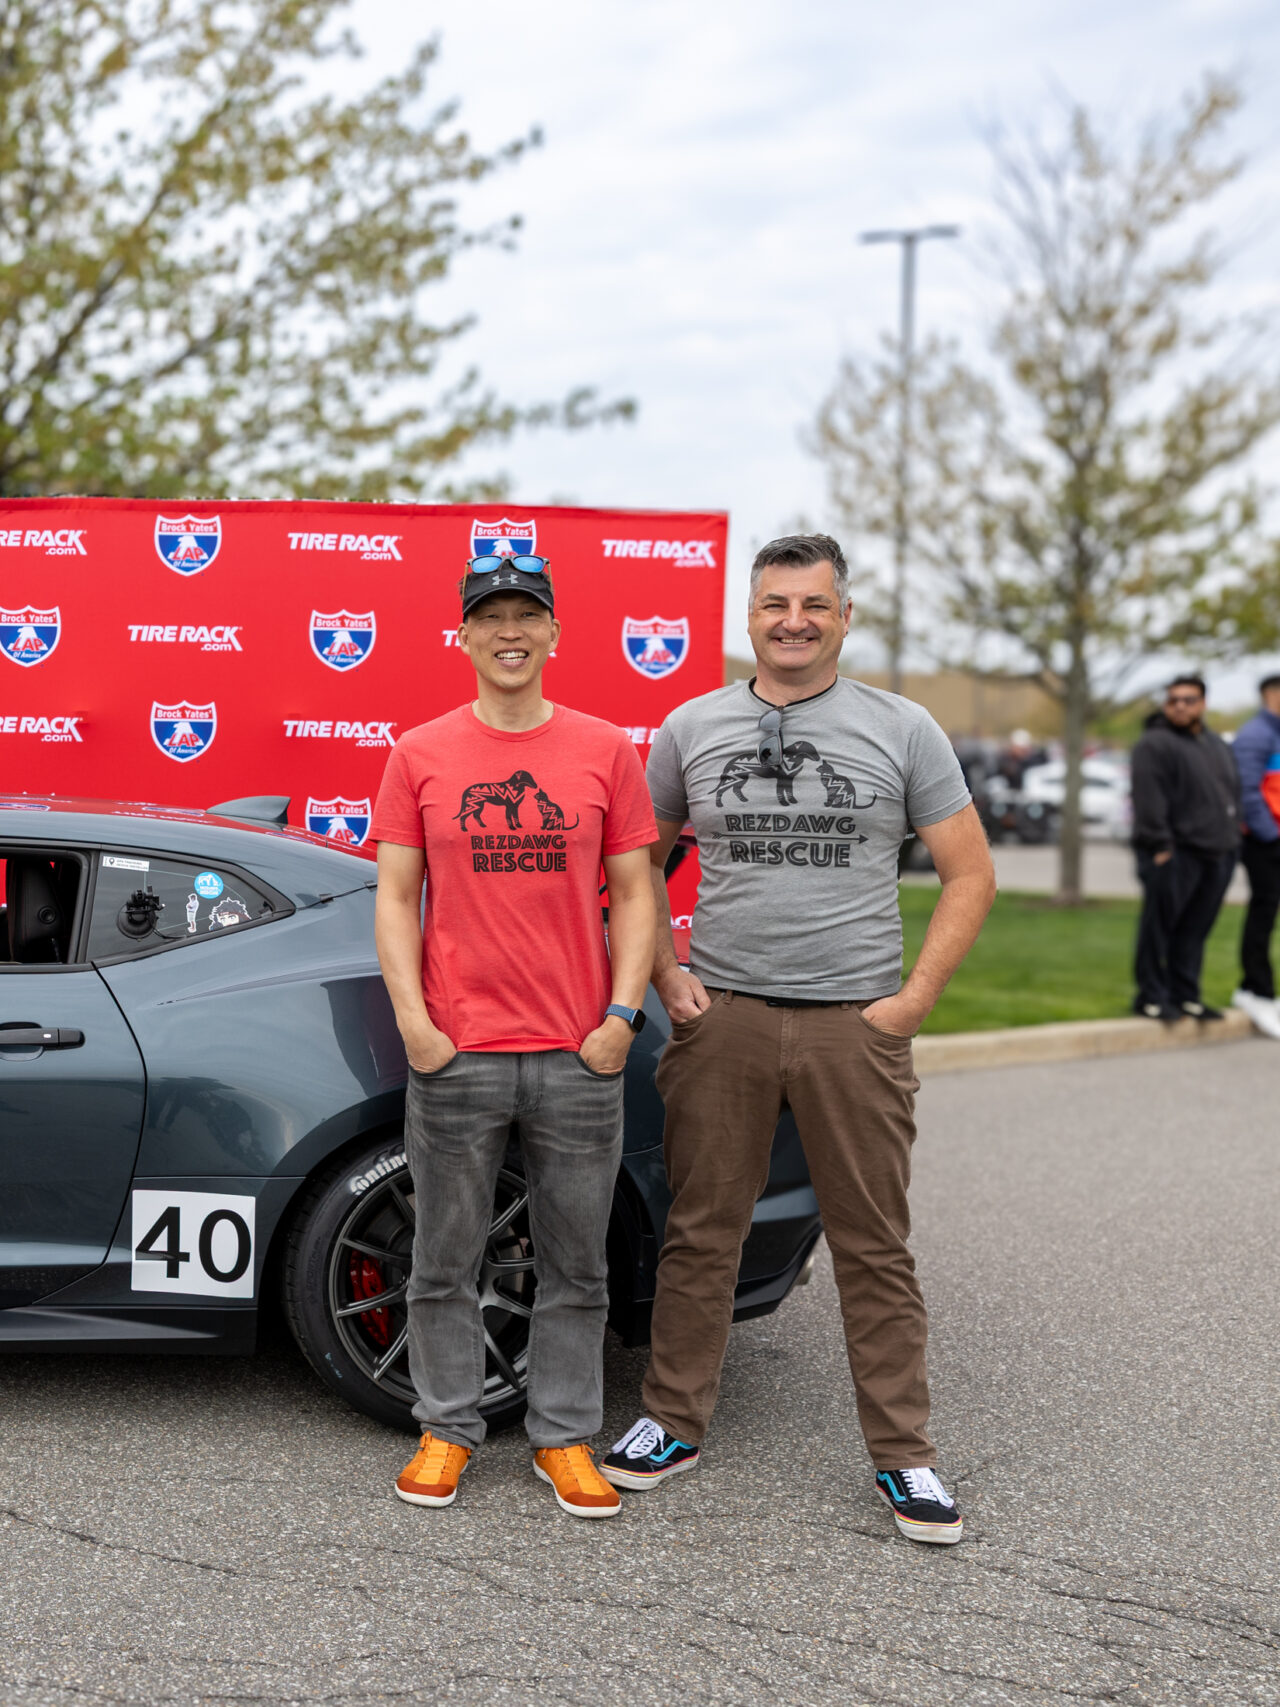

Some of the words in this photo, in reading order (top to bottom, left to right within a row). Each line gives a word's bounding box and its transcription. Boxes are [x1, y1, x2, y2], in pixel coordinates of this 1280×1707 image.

[161, 523, 186, 532] Brock
[478, 526, 502, 535] Brock
[24, 530, 88, 556] RACK
[288, 533, 339, 550] TIRE
[340, 534, 404, 560] RACK
[46, 548, 76, 556] .com
[172, 547, 203, 561] LAP
[361, 552, 392, 560] .com
[602, 540, 653, 557] TIRE
[654, 541, 718, 566] RACK
[1, 614, 26, 622] Brock
[316, 618, 340, 626] Brock
[12, 638, 43, 652] LAP
[128, 625, 179, 642] TIRE
[180, 626, 244, 652] RACK
[201, 644, 232, 652] .com
[326, 642, 358, 656] LAP
[157, 709, 182, 718] Brock
[20, 718, 84, 743] RACK
[283, 720, 334, 738] TIRE
[335, 722, 398, 748] RACK
[41, 734, 72, 743] .com
[168, 733, 199, 747] LAP
[356, 739, 387, 748] .com
[725, 814, 856, 834] REZDAWG
[471, 835, 567, 850] REZDAWG
[730, 841, 851, 868] RESCUE
[473, 852, 567, 872] RESCUE
[135, 1206, 252, 1283] 40
